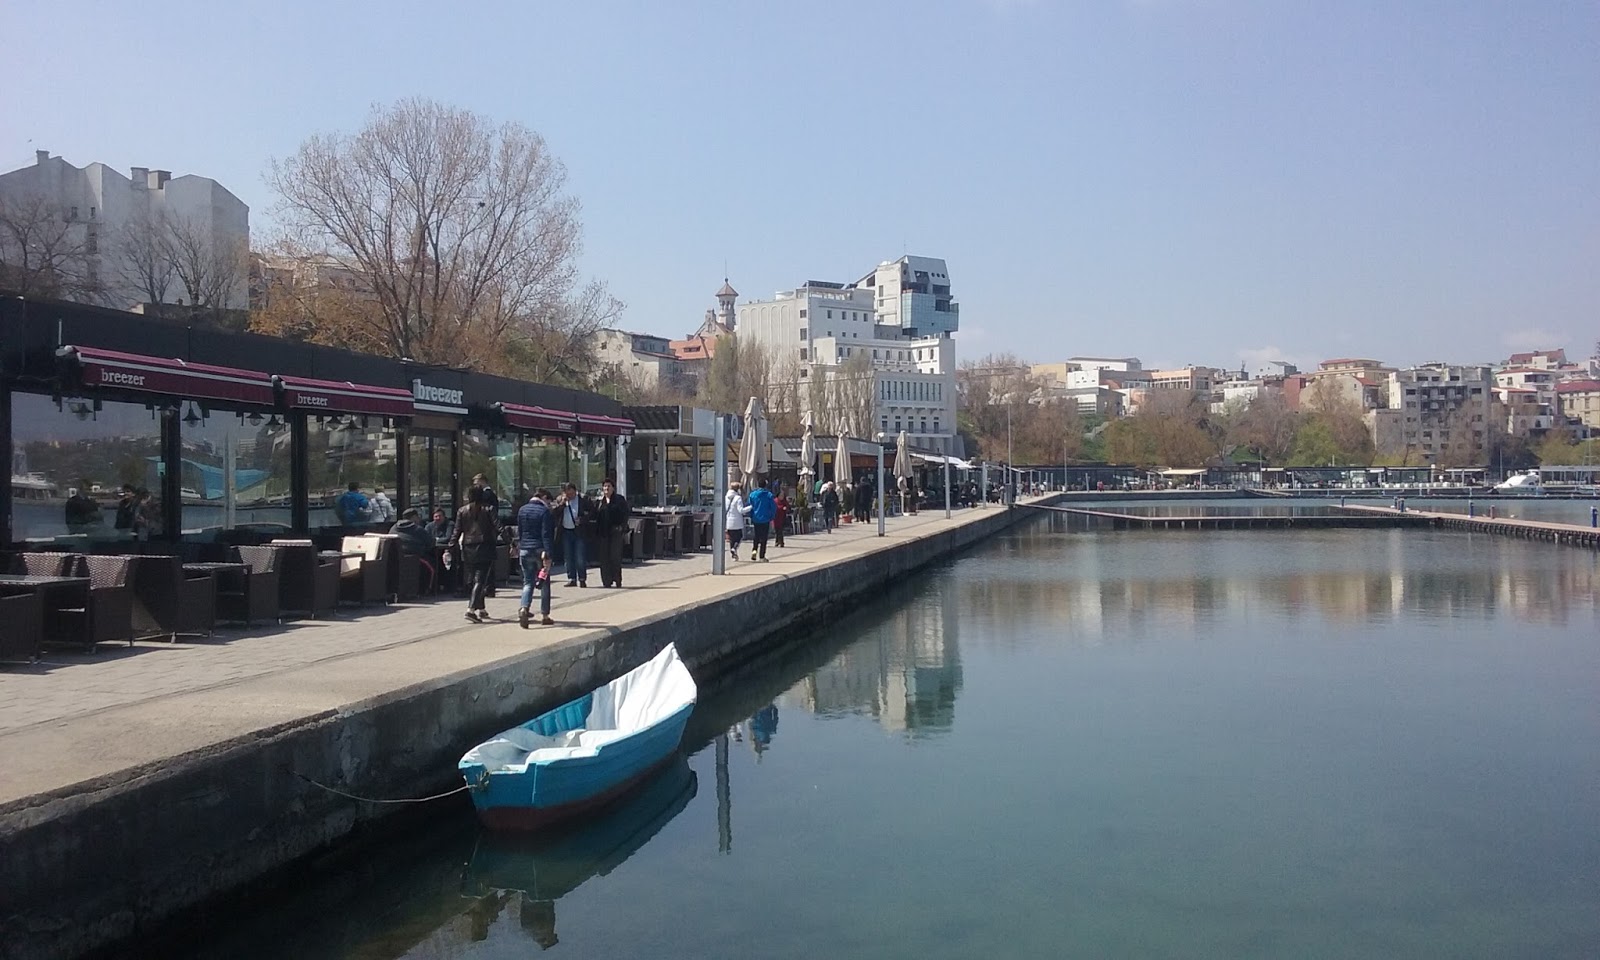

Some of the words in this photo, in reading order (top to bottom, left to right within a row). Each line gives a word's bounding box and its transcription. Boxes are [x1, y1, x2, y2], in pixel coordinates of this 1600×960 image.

[101, 368, 145, 386] breezer
[297, 393, 328, 406] breezer
[413, 379, 463, 405] breezer
